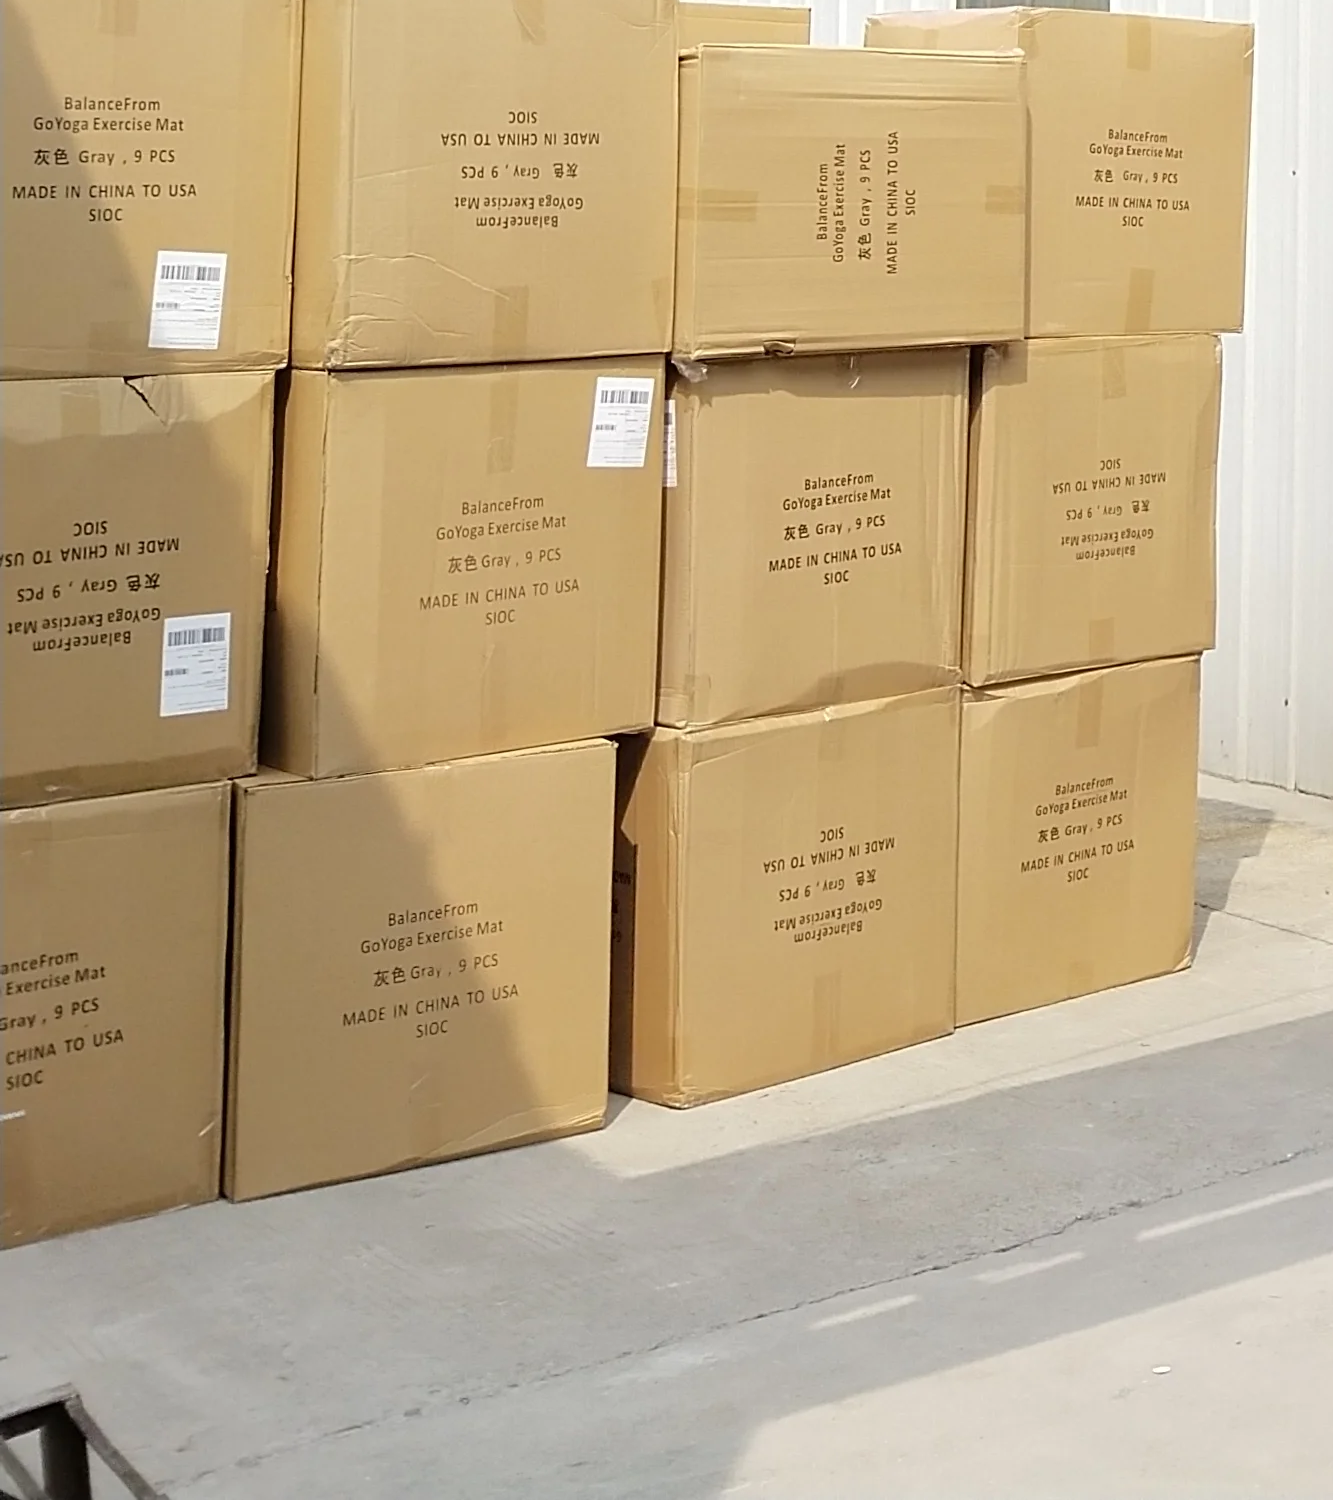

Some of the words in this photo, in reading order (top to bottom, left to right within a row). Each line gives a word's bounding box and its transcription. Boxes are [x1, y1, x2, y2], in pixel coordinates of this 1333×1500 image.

[64, 98, 160, 112] BalanceFrom
[34, 117, 89, 133] GoYoga
[93, 118, 152, 131] Exercise
[156, 118, 184, 132] Mat
[509, 112, 538, 124] SIOC
[441, 133, 467, 146] USA
[474, 133, 491, 146] TO
[498, 133, 538, 146] CHINA
[544, 133, 556, 145] IN
[564, 133, 600, 145] MADE
[888, 132, 899, 154] USA
[1109, 129, 1168, 143] BalanceFrom
[34, 149, 70, 165] 灰色
[134, 150, 143, 163] 9
[150, 150, 175, 163] PCS
[834, 144, 846, 167] Mat
[1090, 143, 1124, 158] GoYoga
[1127, 146, 1163, 157] Exercise
[1165, 148, 1183, 159] Mat
[860, 150, 871, 171] PCS
[888, 161, 898, 175] TO
[462, 166, 484, 178] PCS
[492, 166, 498, 178] 9
[553, 163, 578, 178] 灰色
[1094, 169, 1113, 183] 灰色
[1153, 173, 1158, 182] 9
[1162, 173, 1178, 184] PCS
[12, 186, 57, 199] MADE
[66, 186, 81, 198] IN
[89, 185, 135, 198] CHINA
[142, 184, 161, 197] TO
[169, 184, 197, 197] USA
[833, 170, 845, 217] Exercise
[887, 181, 898, 217] CHINA
[454, 197, 479, 209] Mat
[484, 197, 535, 211] Exercise
[539, 195, 583, 209] GoYoga
[816, 164, 828, 240] BalanceFrom
[906, 190, 916, 216] SIOC
[1076, 196, 1104, 207] MADE
[1109, 197, 1119, 207] IN
[1123, 198, 1152, 208] CHINA
[1157, 200, 1168, 209] TO
[1172, 201, 1190, 211] USA
[89, 208, 123, 222] SIOC
[476, 216, 558, 228] BalanceFrom
[1122, 216, 1144, 227] SIOC
[887, 223, 897, 234] IN
[833, 220, 847, 263] GoYoga
[858, 233, 871, 260] 灰色
[887, 241, 897, 274] MADE
[805, 474, 874, 490] BalanceFrom
[783, 497, 823, 511] GoYoga
[826, 491, 868, 506] Exercise
[870, 488, 891, 500] Mat
[74, 521, 107, 536] SIOC
[784, 524, 810, 540] 灰色
[856, 518, 861, 529] 9
[867, 515, 885, 527] PCS
[61, 545, 107, 561] CHINA
[116, 544, 130, 557] IN
[138, 538, 179, 554] MADE
[33, 551, 52, 564] TO
[769, 557, 802, 572] MADE
[807, 554, 818, 567] IN
[824, 549, 858, 564] CHINA
[862, 546, 876, 558] TO
[881, 542, 901, 556] USA
[126, 573, 160, 591] 灰色
[824, 570, 849, 585] SIOC
[17, 589, 44, 602] PCS
[53, 585, 61, 599] 9
[43, 614, 103, 631] Exercise
[108, 608, 160, 623] GoYoga
[7, 621, 37, 634] Mat
[33, 631, 131, 651] BalanceFrom
[1056, 777, 1114, 796] BalanceFrom
[1036, 802, 1069, 816] GoYoga
[1072, 793, 1107, 810] Exercise
[1110, 790, 1128, 801] Mat
[1038, 827, 1060, 843] 灰色
[1097, 818, 1102, 829] 9
[1107, 814, 1123, 827] PCS
[1021, 857, 1049, 872] MADE
[1054, 854, 1064, 866] IN
[1069, 847, 1097, 863] CHINA
[1102, 844, 1113, 856] TO
[1117, 839, 1134, 852] USA
[1068, 868, 1089, 883] SIOC
[6, 973, 70, 995] Exercise
[75, 966, 106, 982] Mat
[55, 1005, 63, 1019] 9
[72, 998, 99, 1015] PCS
[6, 1043, 56, 1066] CHINA
[65, 1037, 85, 1053] TO
[93, 1029, 124, 1047] USA
[6, 1070, 44, 1091] SIOC
